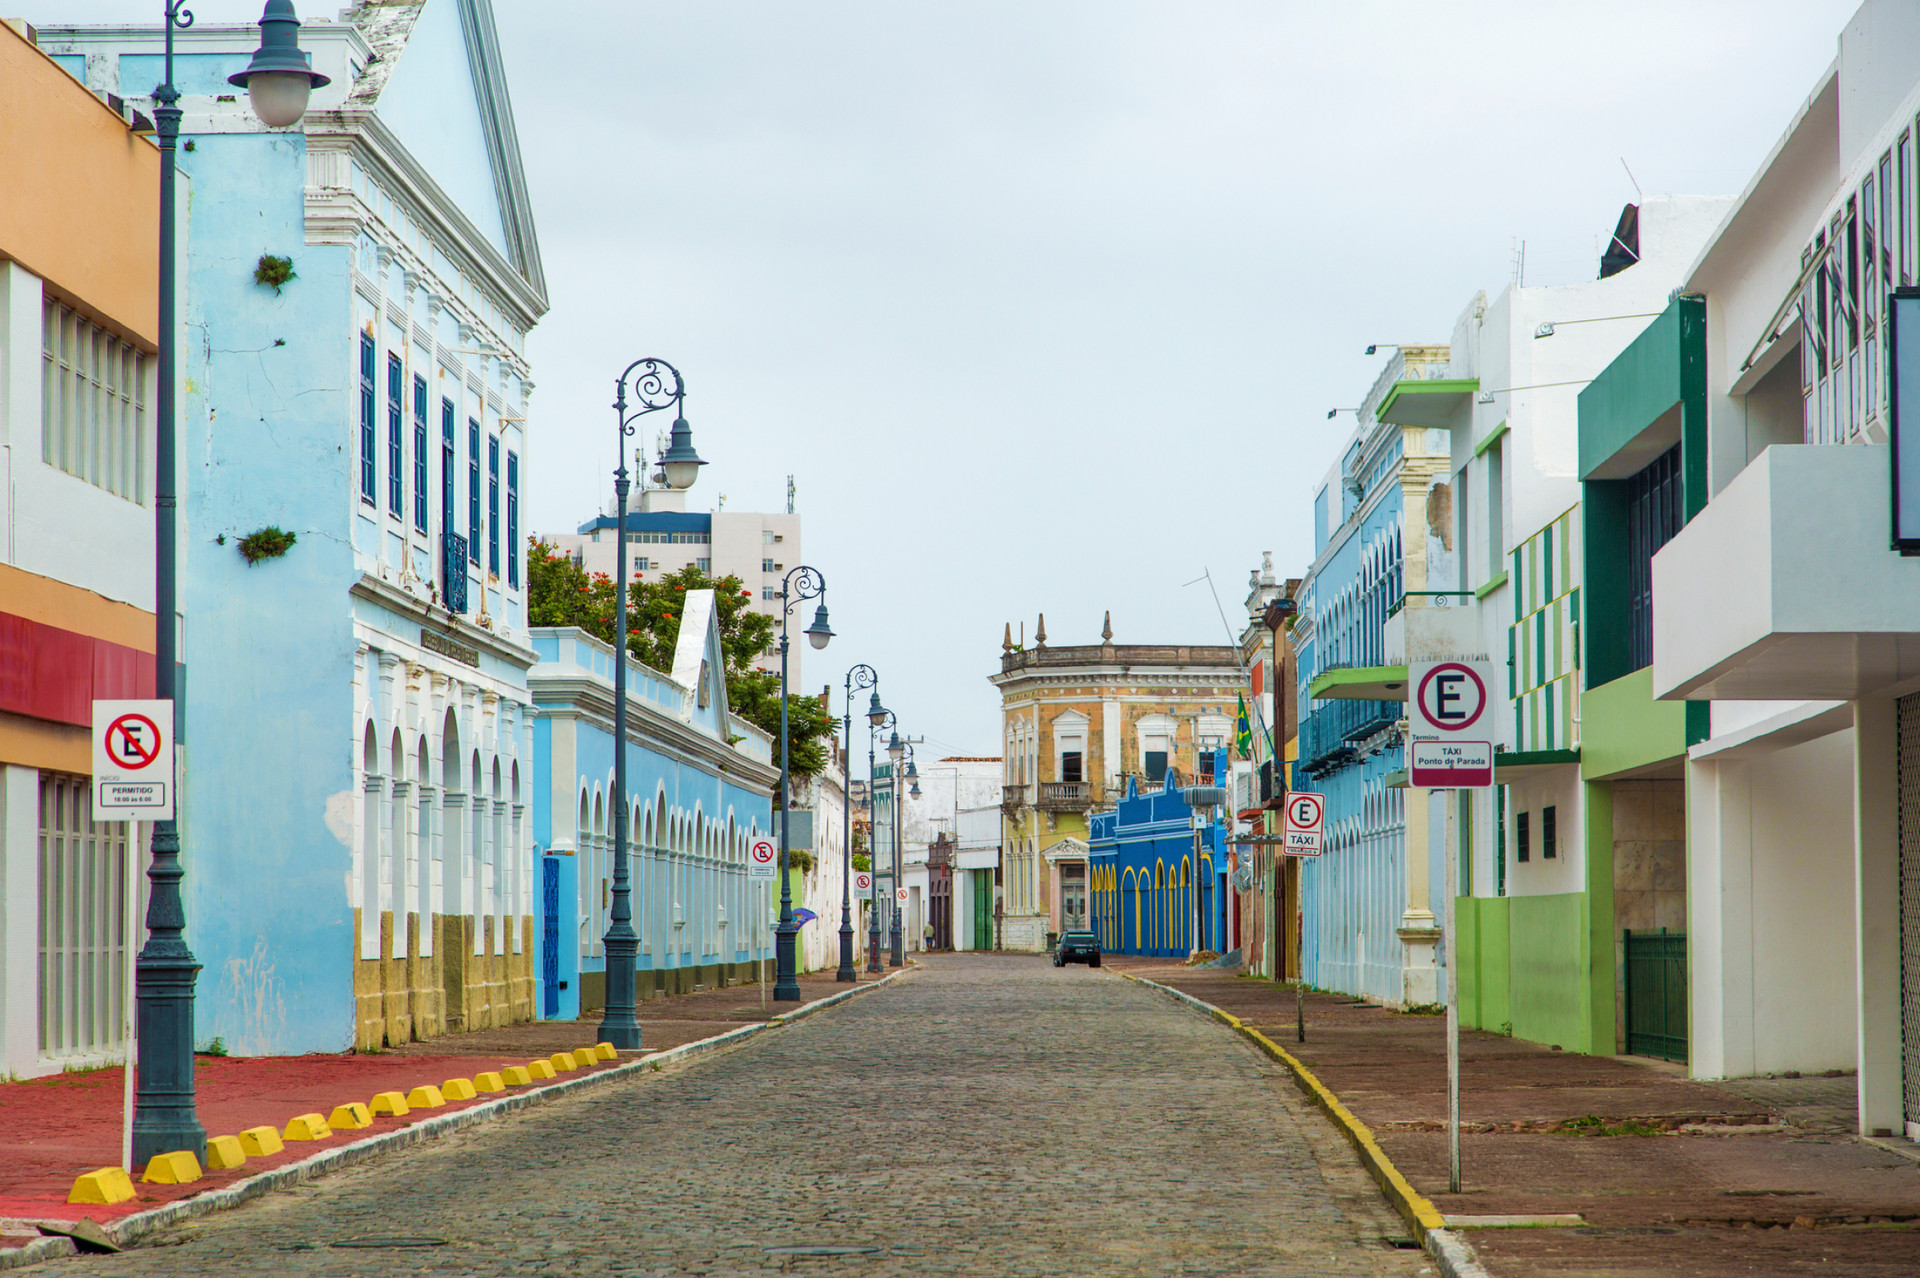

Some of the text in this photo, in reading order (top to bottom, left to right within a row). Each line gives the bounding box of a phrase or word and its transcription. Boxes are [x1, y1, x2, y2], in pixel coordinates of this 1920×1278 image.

[1436, 675, 1466, 719] E
[1418, 757, 1486, 765] Ponto de Parada
[1299, 804, 1310, 821] E
[1291, 834, 1314, 845] TÁXI
